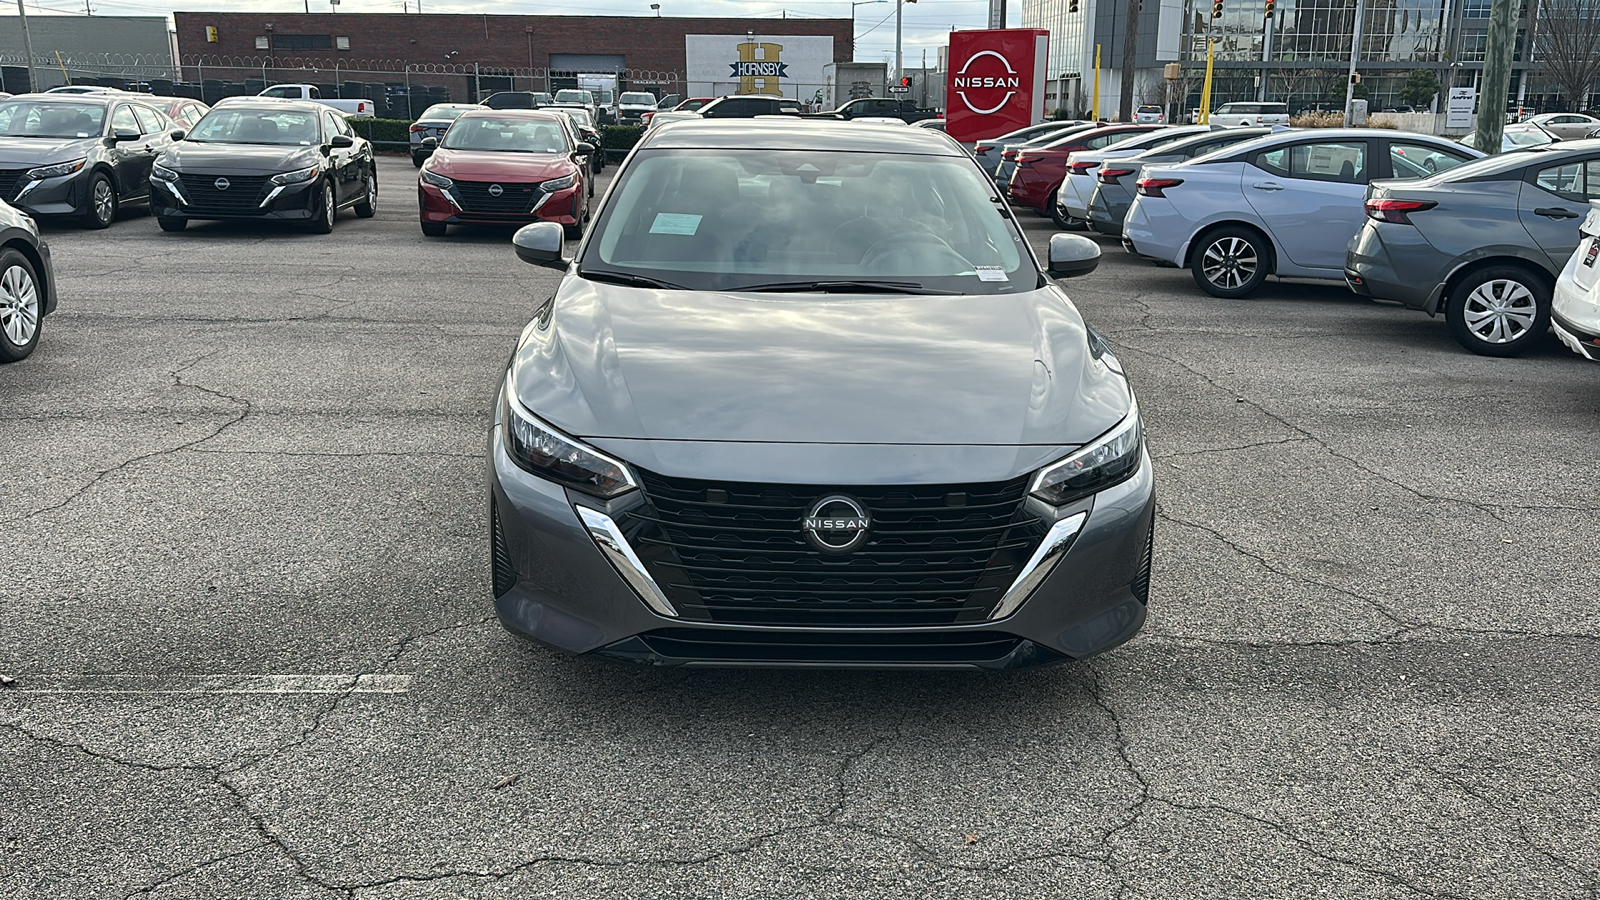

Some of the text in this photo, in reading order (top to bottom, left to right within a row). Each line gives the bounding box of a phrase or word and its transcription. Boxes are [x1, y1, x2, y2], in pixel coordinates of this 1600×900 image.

[738, 62, 781, 75] HORNSBY
[954, 77, 1019, 88] NISSAN
[806, 520, 868, 528] NISSAN
